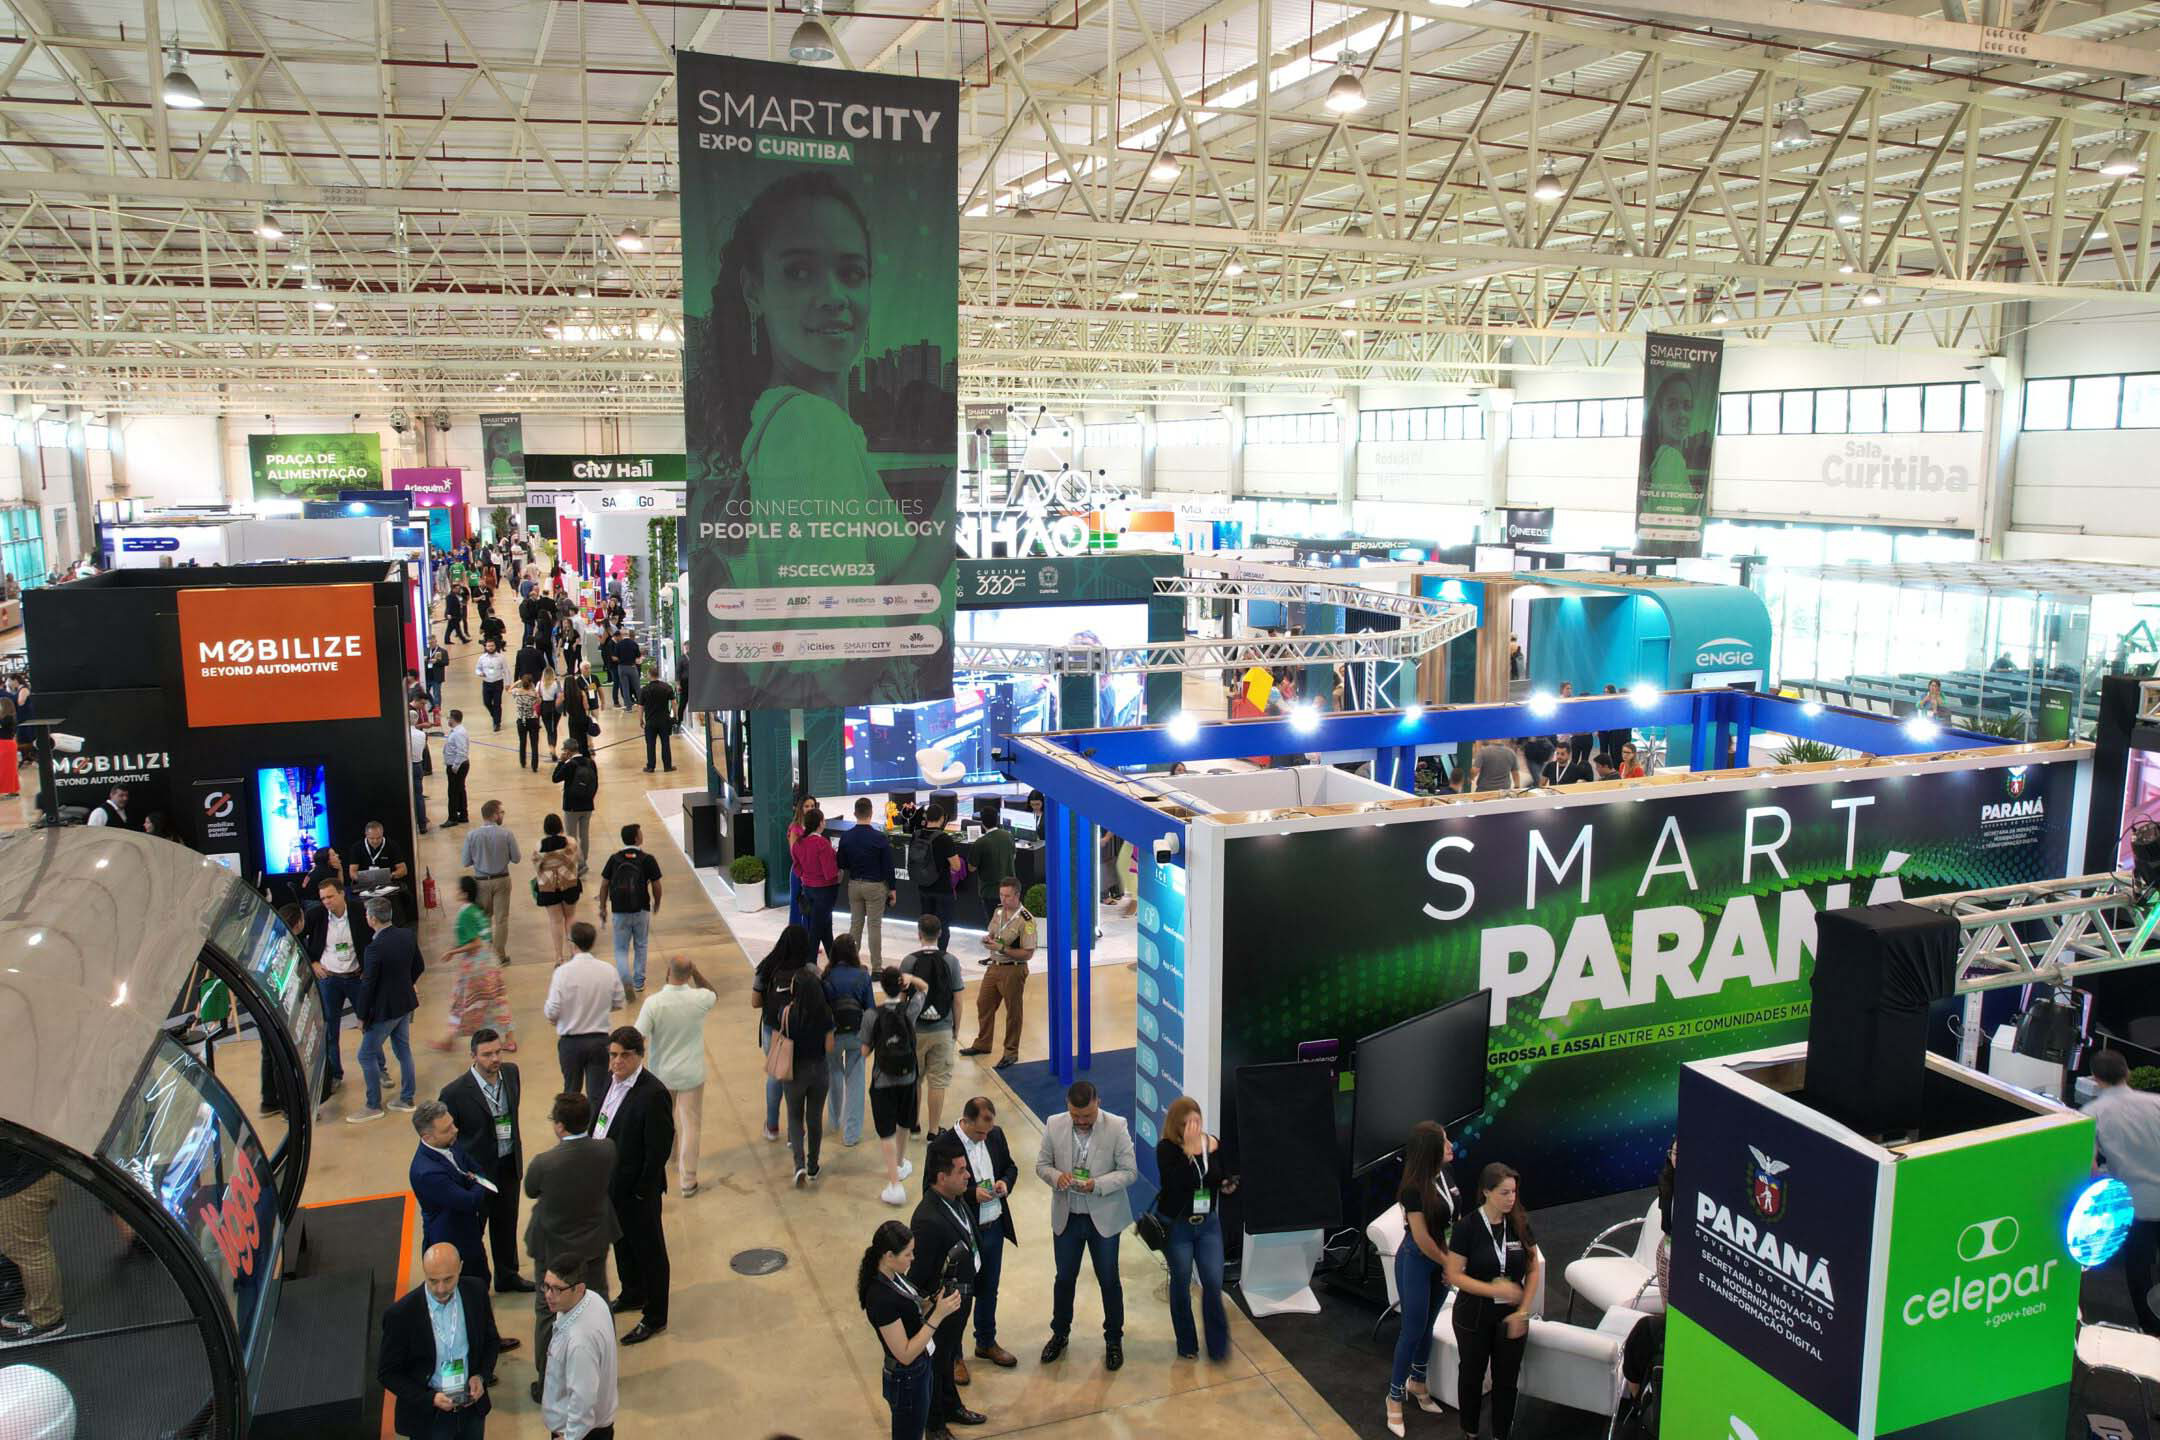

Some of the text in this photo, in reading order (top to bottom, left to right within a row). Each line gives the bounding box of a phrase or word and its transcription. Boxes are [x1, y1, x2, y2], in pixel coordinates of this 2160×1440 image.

[698, 90, 941, 144] SMARTCITY
[699, 133, 850, 161] EXPO CURITIBA
[1650, 344, 1718, 363] SMARTCITY
[266, 453, 336, 467] PRAÇA DE
[1845, 440, 1882, 458] Sala
[267, 465, 367, 481] ALIMENTAÇÃO
[573, 458, 653, 478] City Hall
[1822, 454, 1969, 492] Curitiba
[726, 499, 923, 517] CONNECTING CITIES
[700, 520, 946, 539] PEOPLE & TECHNOLOGY
[778, 563, 876, 578] #SCECWB23
[807, 642, 835, 652] iCities
[844, 641, 891, 650] SMARTCITY
[201, 662, 338, 677] BEYOND AUTOMOTIVE
[90, 774, 150, 785] AUTOMOTIVE
[1982, 796, 2043, 821] PARANÁ
[1422, 796, 1876, 921] SMART
[1488, 1047, 1547, 1066] GROSSA
[1551, 1044, 1560, 1055] E
[1563, 1034, 1605, 1054] ASSAÍ
[1609, 1030, 1654, 1047] ENTRE
[1658, 1027, 1675, 1039] AS
[1679, 1024, 1692, 1036] 21
[1694, 1008, 1788, 1033] COMUNIDADES
[1697, 1191, 1834, 1303] PARANÁ
[1695, 1230, 1834, 1320] GOVERNO DO ESTADO
[1701, 1249, 1824, 1335] SECRETARIA DA INOVAÇÃO,
[1722, 1275, 1795, 1328] MODERNIZAÇÃO
[1903, 1259, 2059, 1326] celepar
[1699, 1272, 1824, 1361] E TRANSFORMAÇÃO DIGITAL
[1984, 1302, 2047, 1328] +gov+tech
